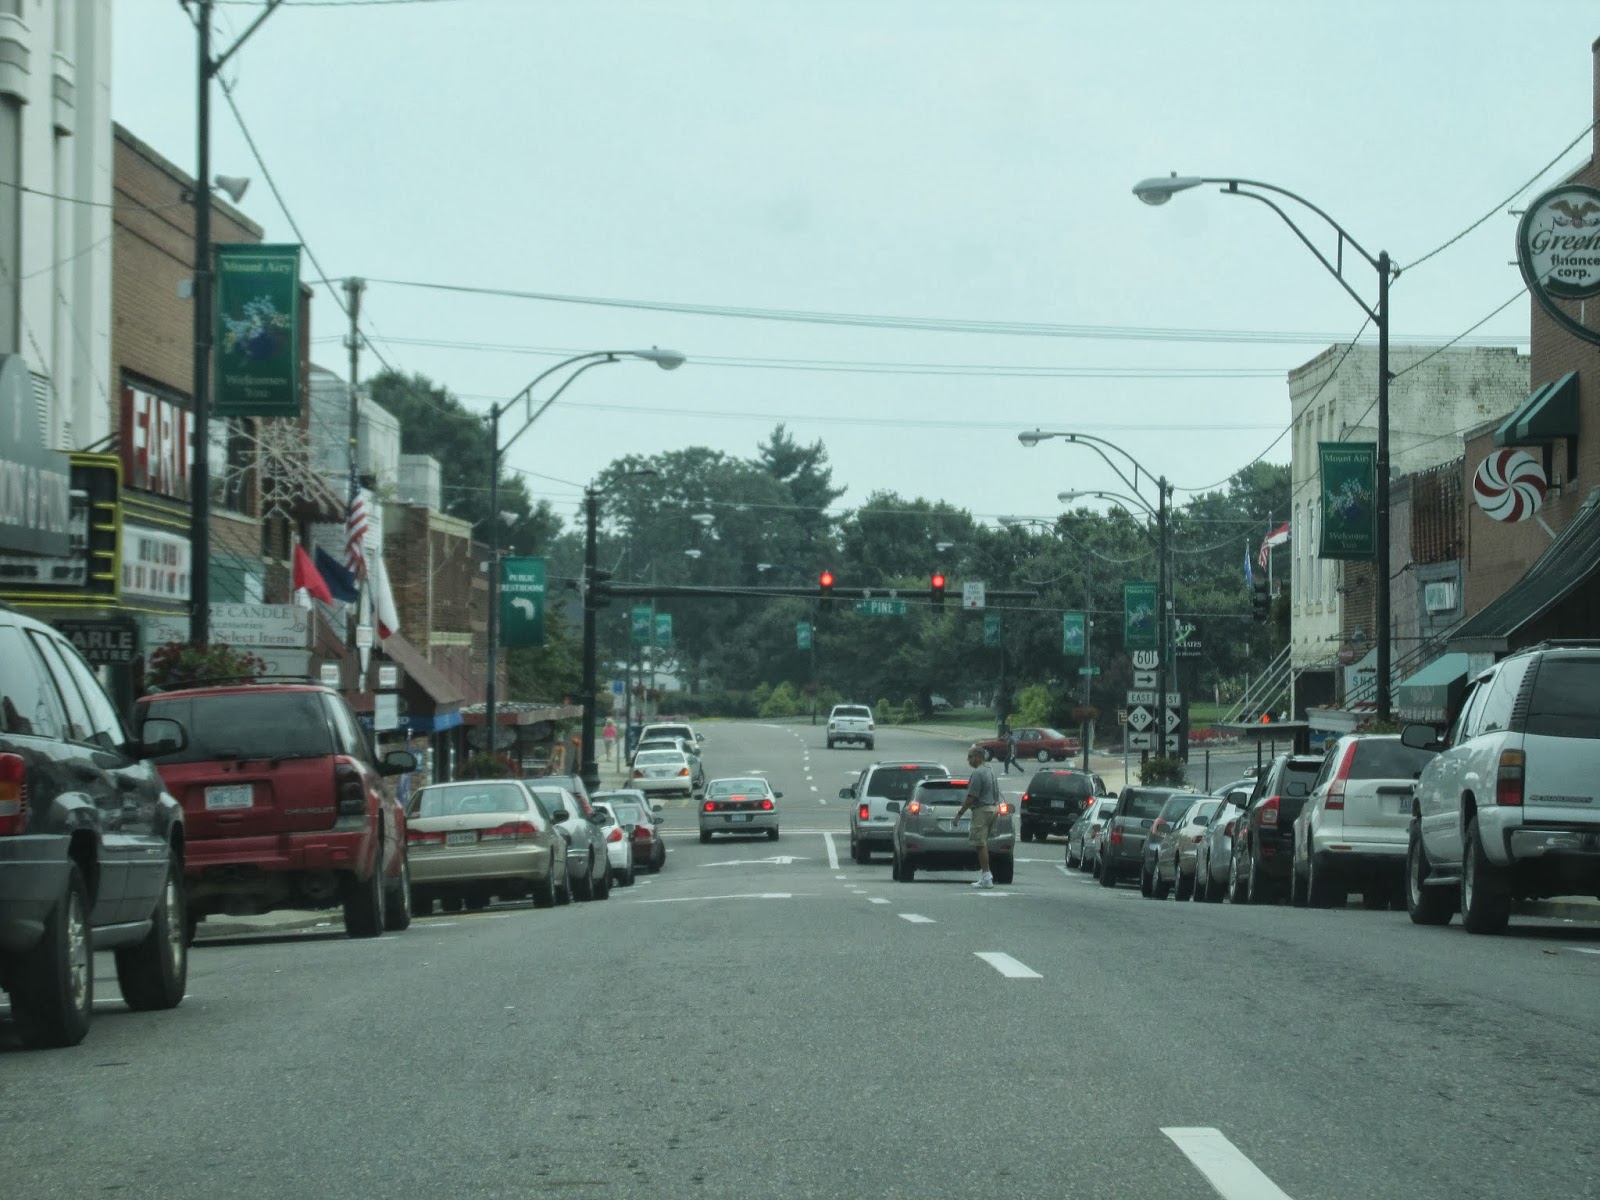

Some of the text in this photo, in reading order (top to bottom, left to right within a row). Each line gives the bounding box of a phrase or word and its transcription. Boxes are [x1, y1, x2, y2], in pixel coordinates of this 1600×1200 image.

[1551, 254, 1600, 266] finance
[224, 261, 291, 275] Mount Airy
[1557, 267, 1591, 280] corp.
[1324, 455, 1352, 463] Mount
[509, 574, 536, 582] PUBLIC
[501, 584, 544, 592] RESTROOM
[228, 606, 290, 619] CANDLE
[871, 601, 894, 613] PINE
[216, 630, 254, 643] Select
[258, 631, 295, 644] Items
[1137, 651, 1154, 665] 601
[1131, 693, 1150, 702] EAST
[1132, 713, 1147, 723] 89
